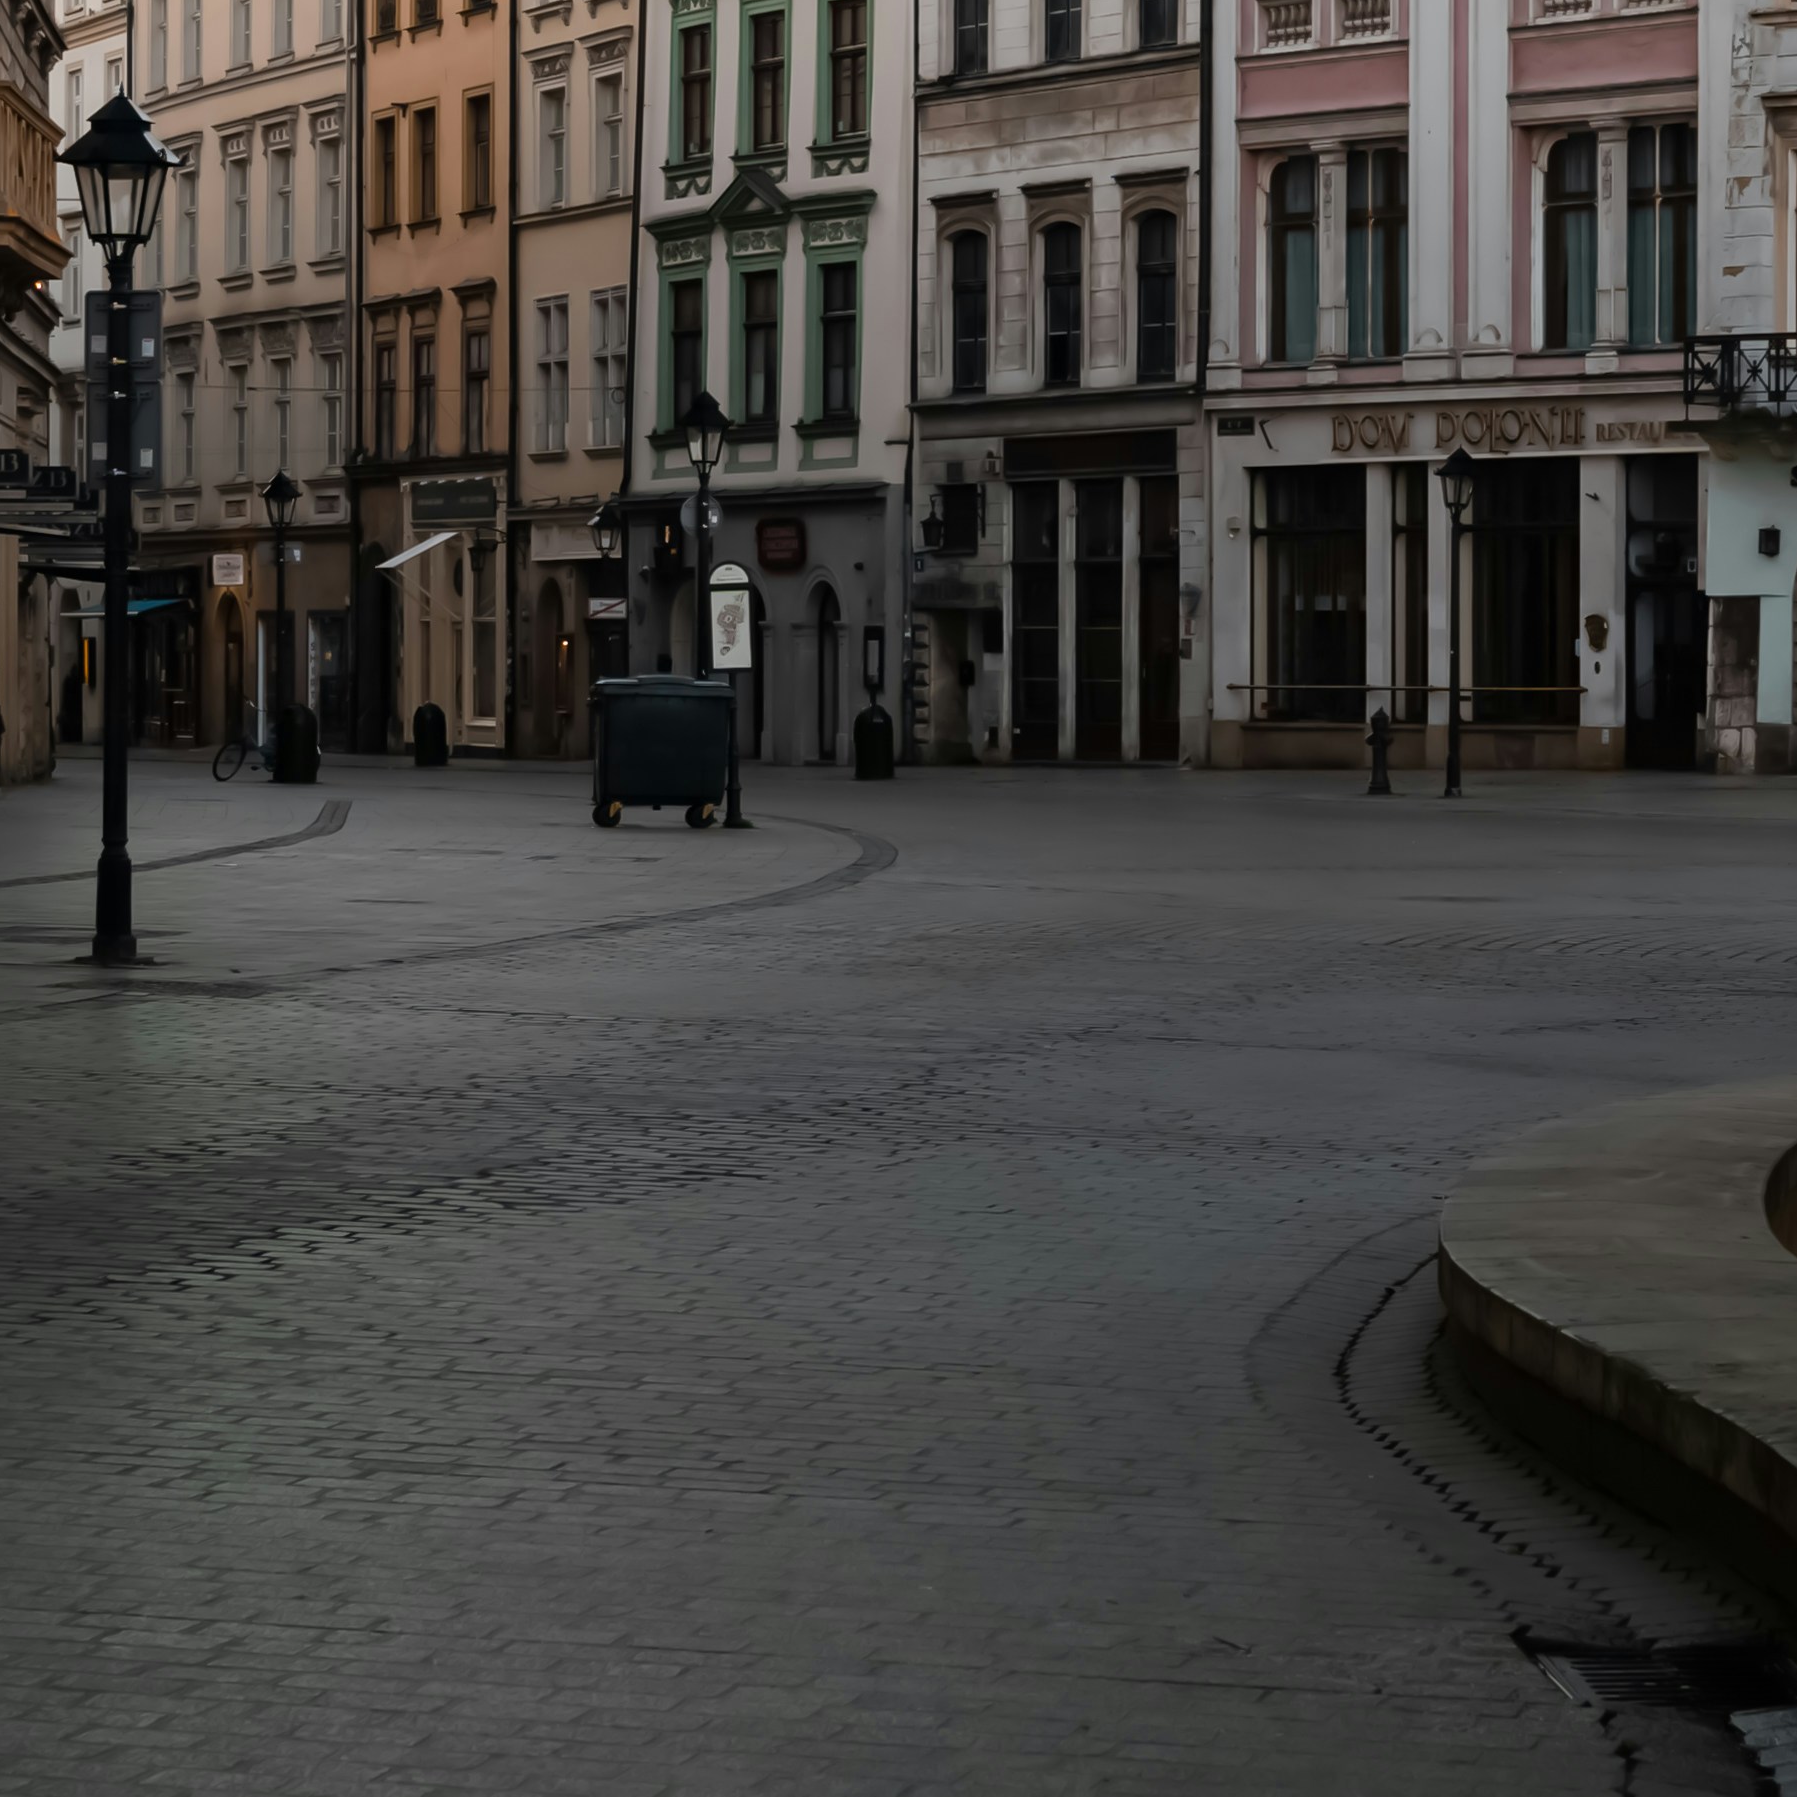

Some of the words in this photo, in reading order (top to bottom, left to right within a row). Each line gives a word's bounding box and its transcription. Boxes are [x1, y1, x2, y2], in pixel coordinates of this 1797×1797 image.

[1331, 412, 1415, 454] DOM
[1434, 407, 1586, 456] POLONII
[0, 453, 20, 472] 13
[50, 470, 67, 488] 13
